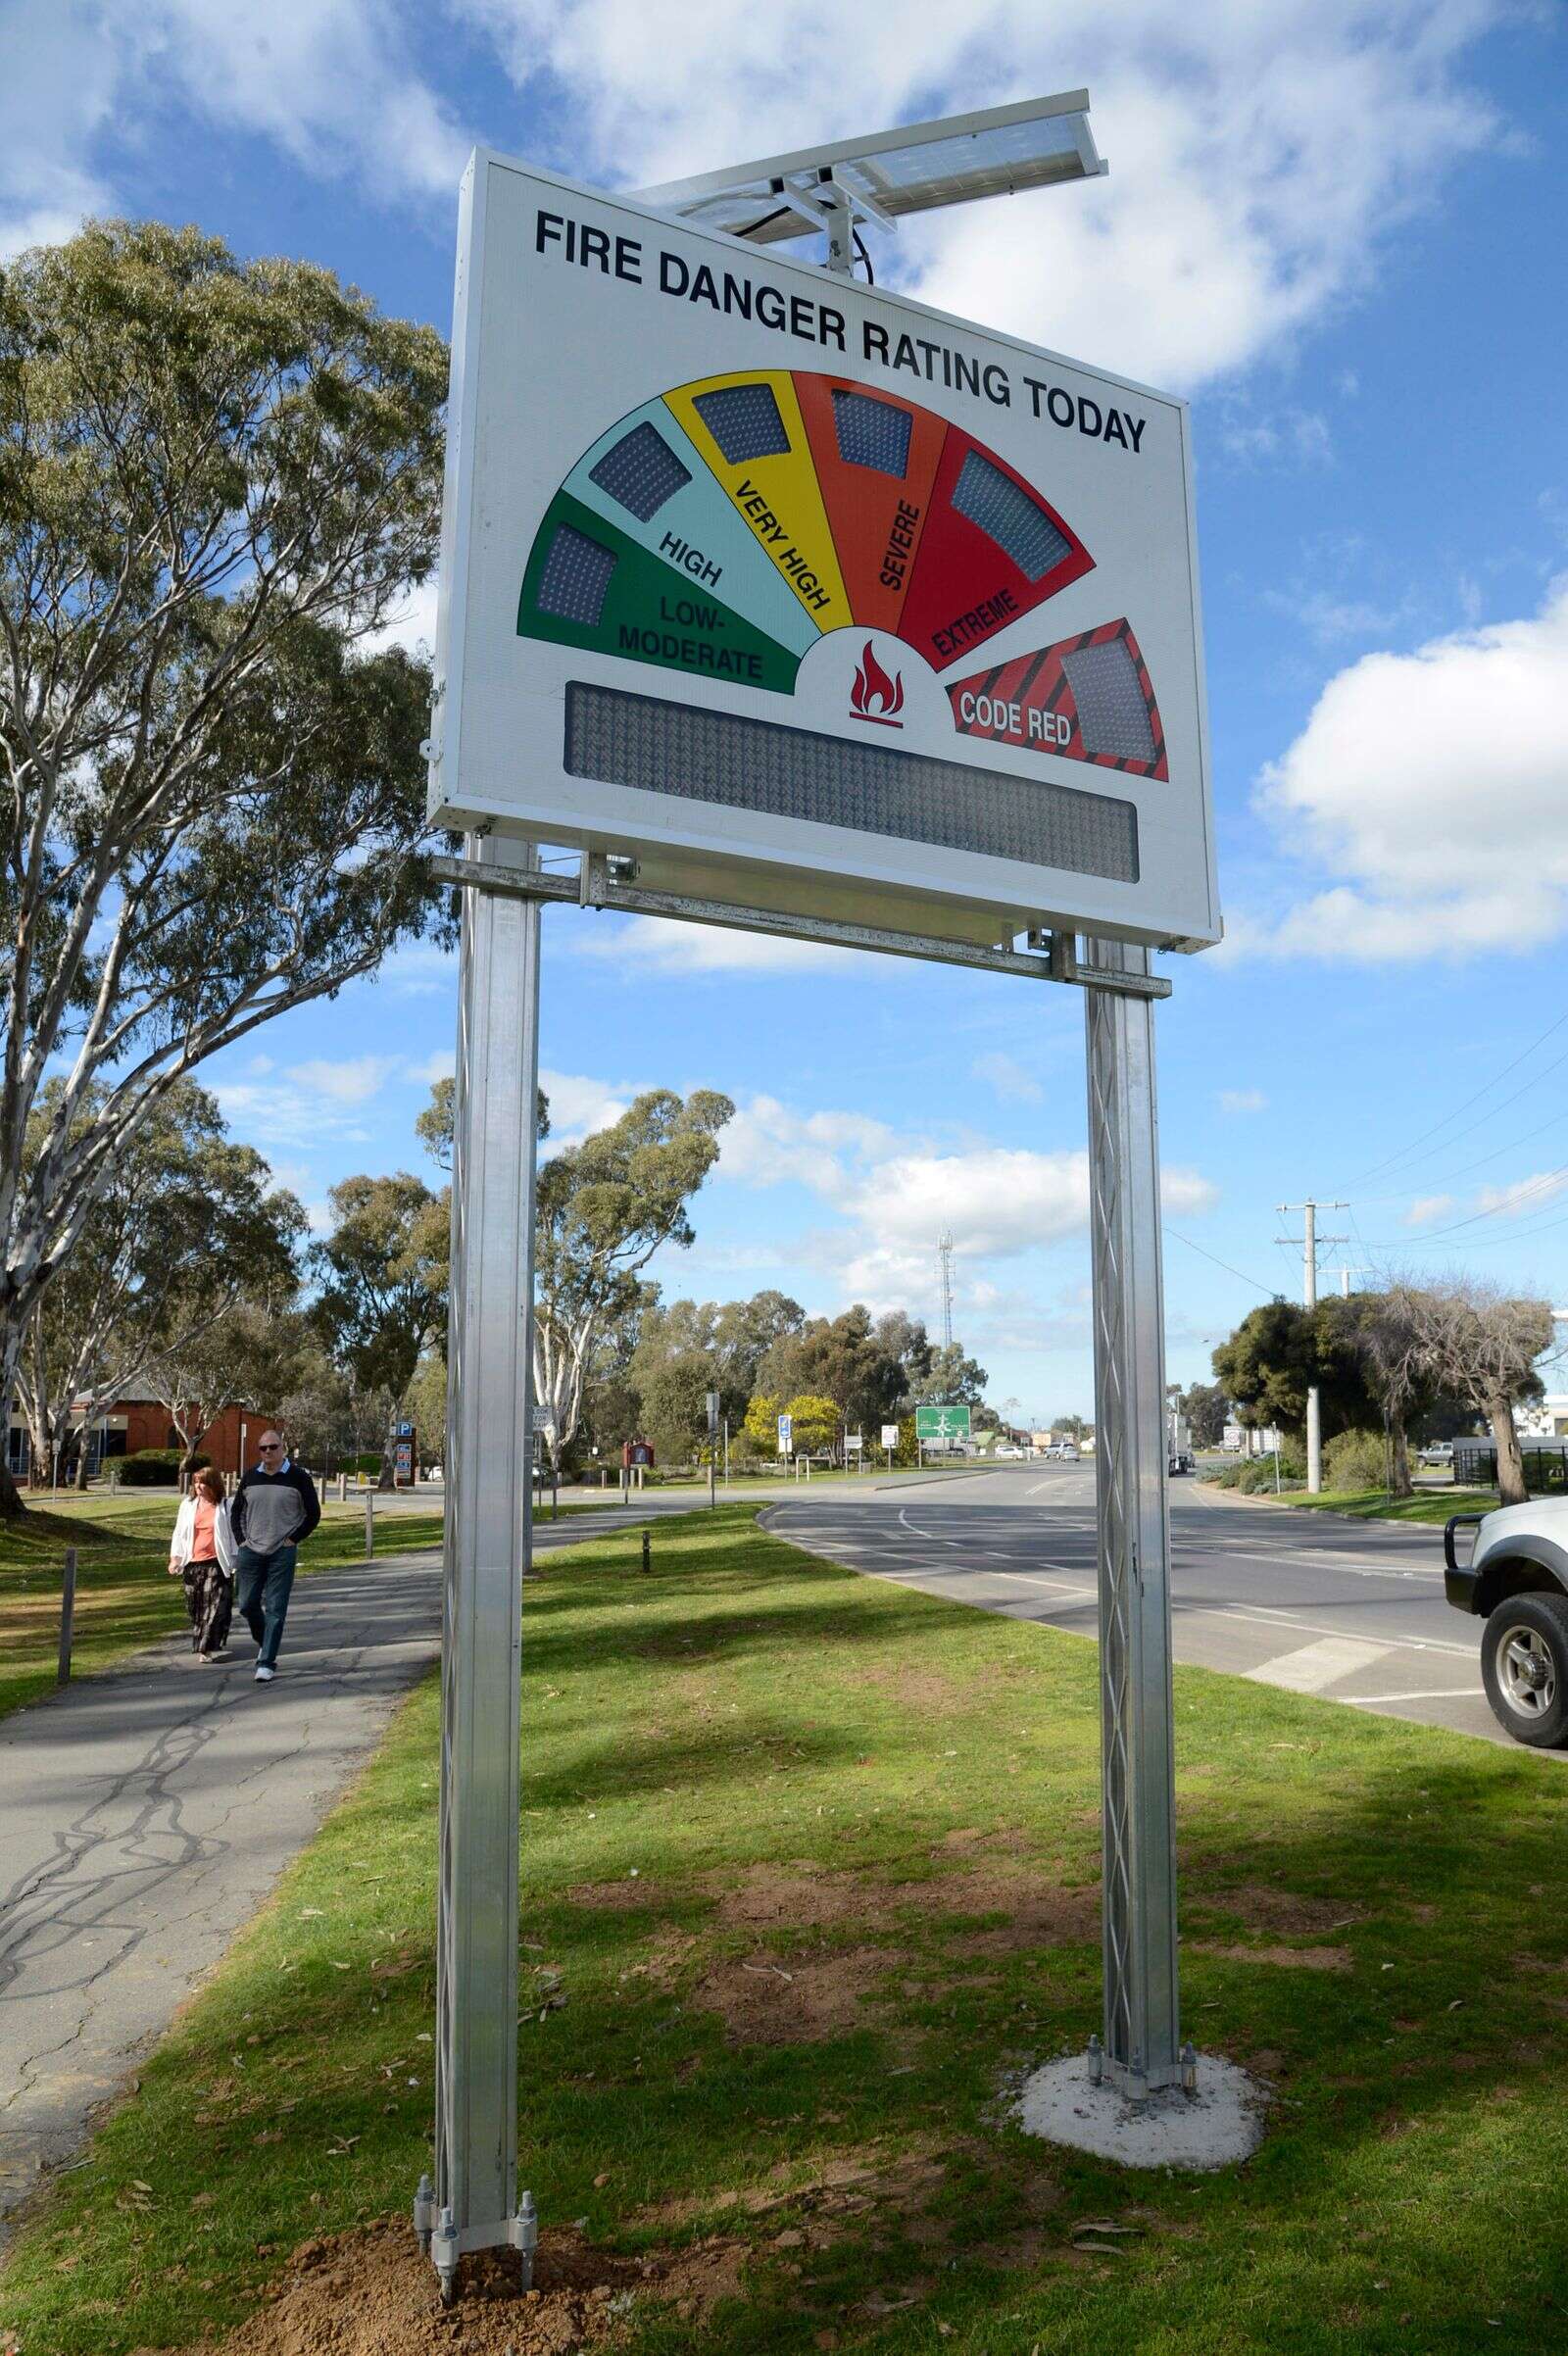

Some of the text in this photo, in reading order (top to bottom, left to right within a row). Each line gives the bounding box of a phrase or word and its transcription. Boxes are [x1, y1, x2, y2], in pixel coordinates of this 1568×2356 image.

[536, 210, 1146, 453] FIRE DANGER RATING TODAY
[659, 531, 723, 588] HIGH
[736, 479, 831, 611] VERY HIGH
[879, 500, 919, 591] SEVERE
[660, 596, 725, 631] LOW-
[931, 588, 1019, 657] EXTREME
[618, 623, 763, 680] MODERATE
[959, 691, 1071, 746] CODE RED
